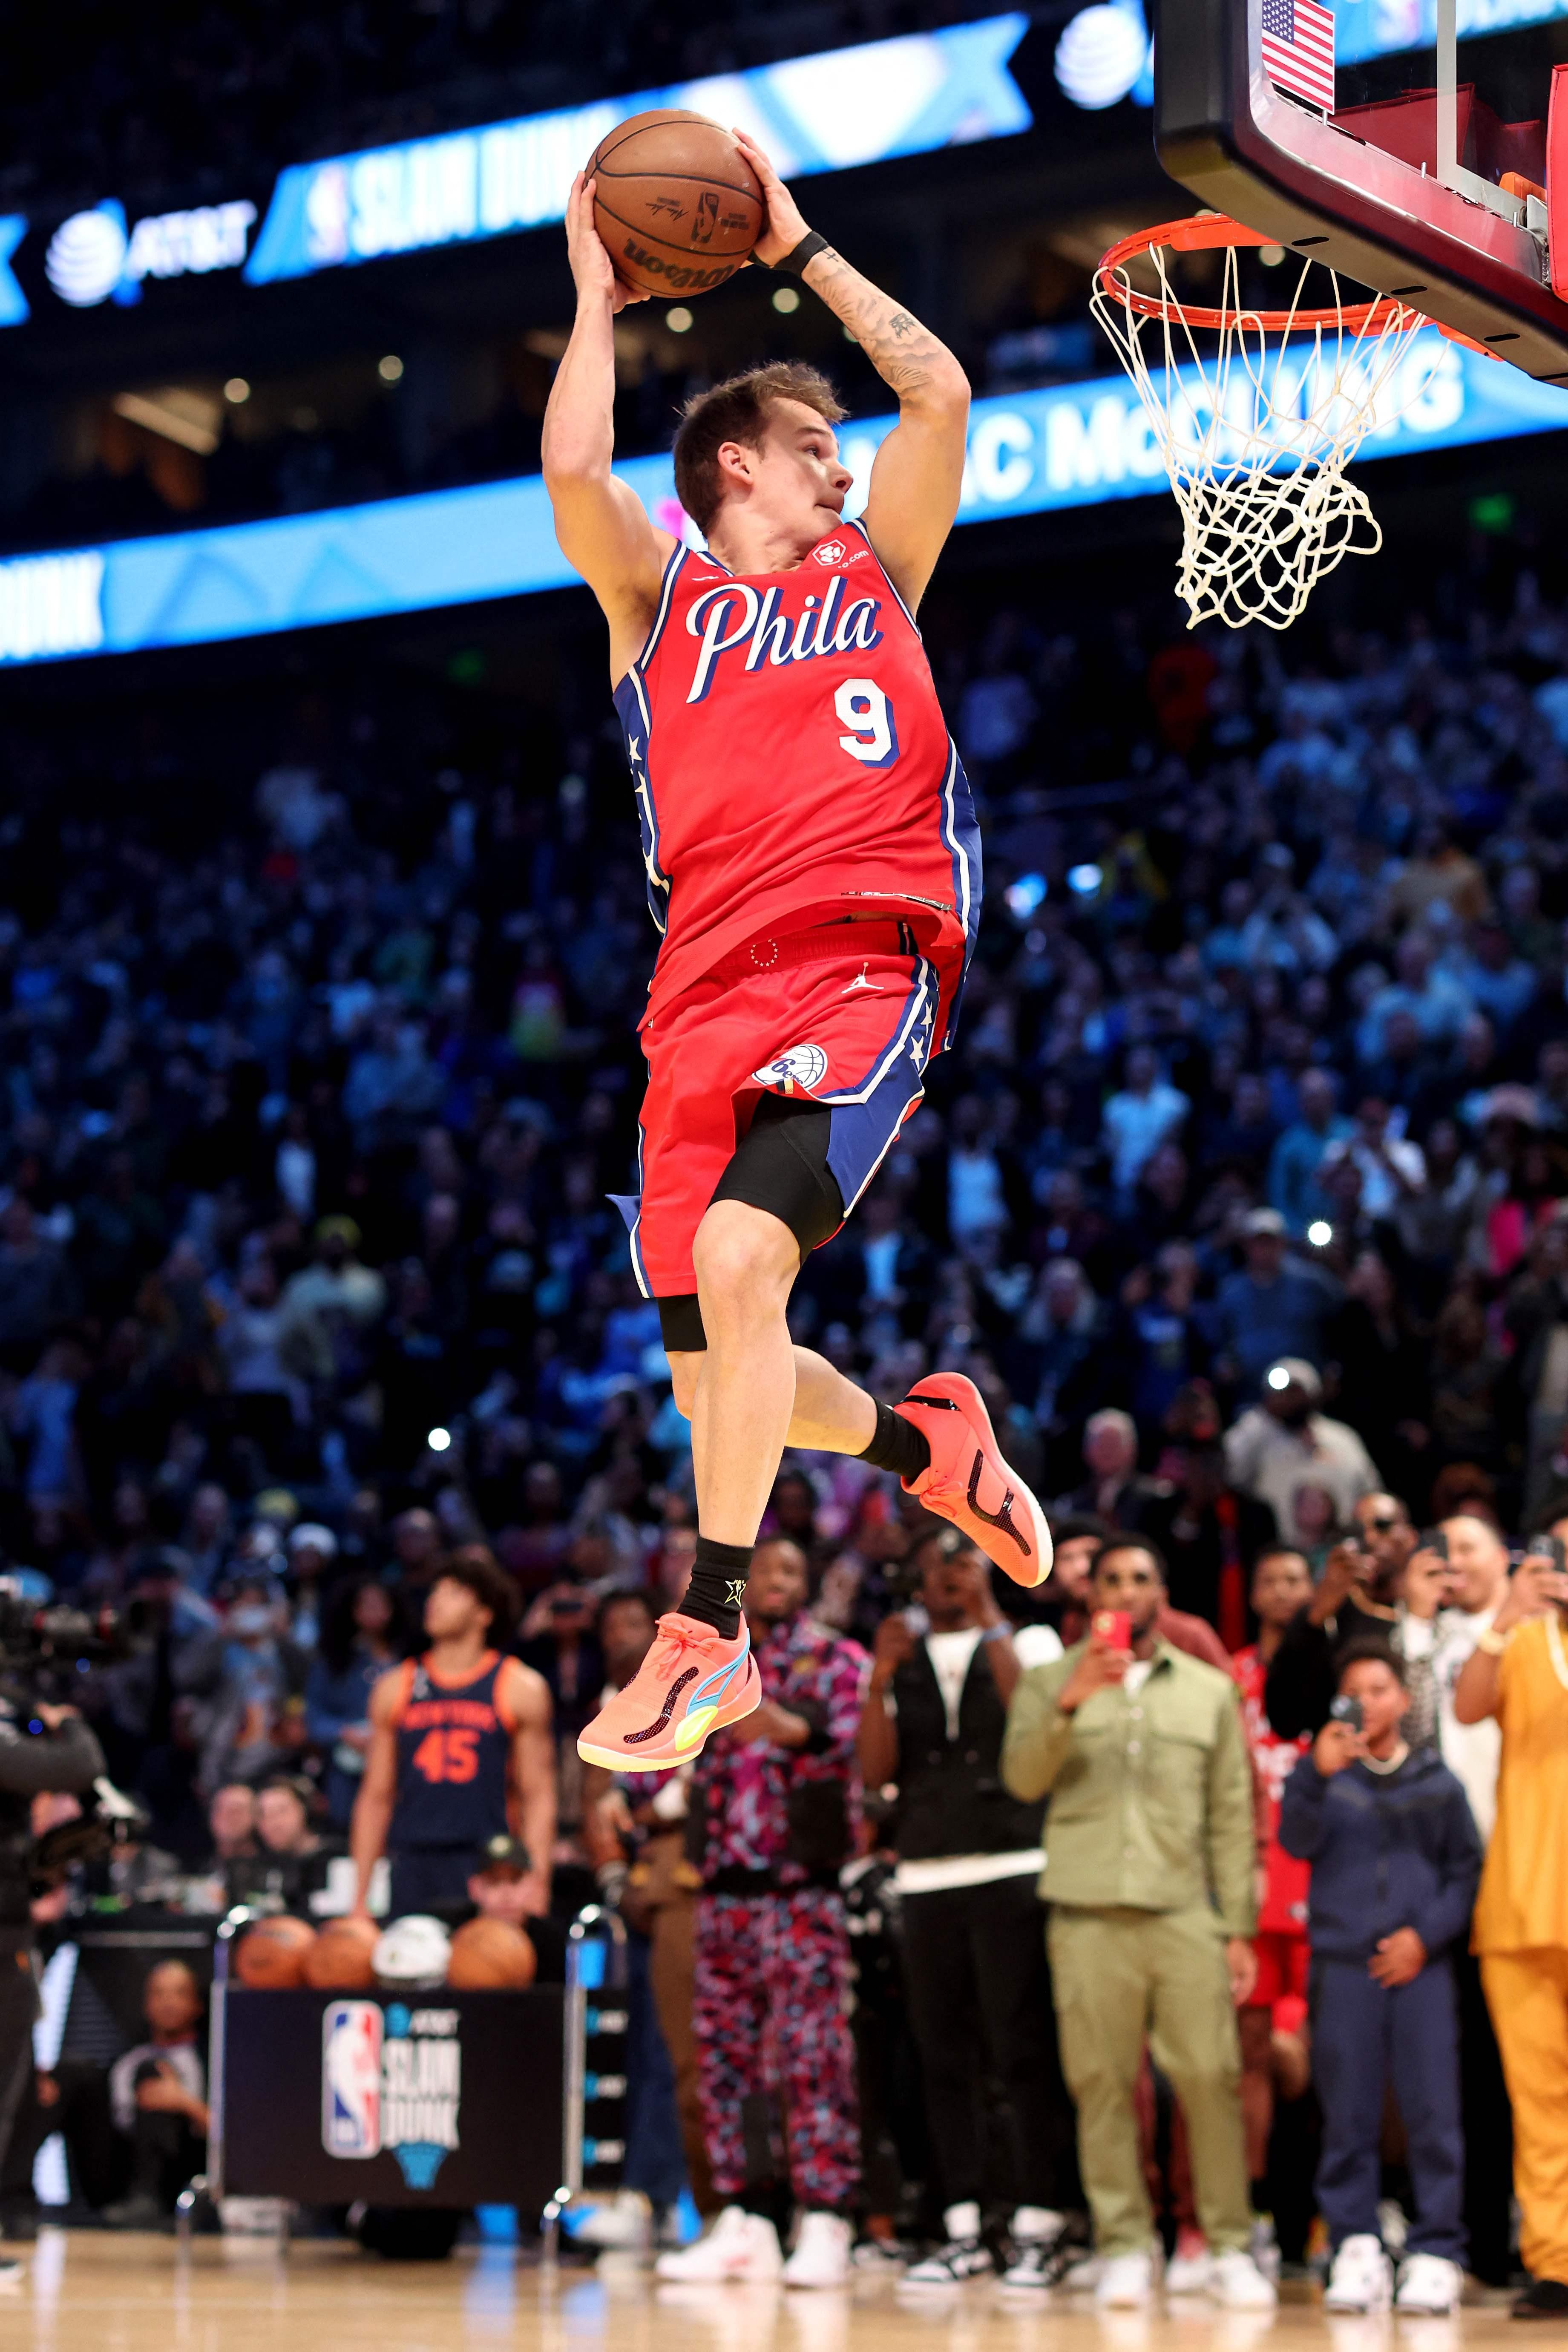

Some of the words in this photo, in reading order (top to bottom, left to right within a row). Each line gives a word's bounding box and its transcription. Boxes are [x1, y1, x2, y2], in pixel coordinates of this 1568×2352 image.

[685, 575, 884, 704] Phila
[834, 678, 901, 769] 9
[413, 1728, 480, 1784] 45
